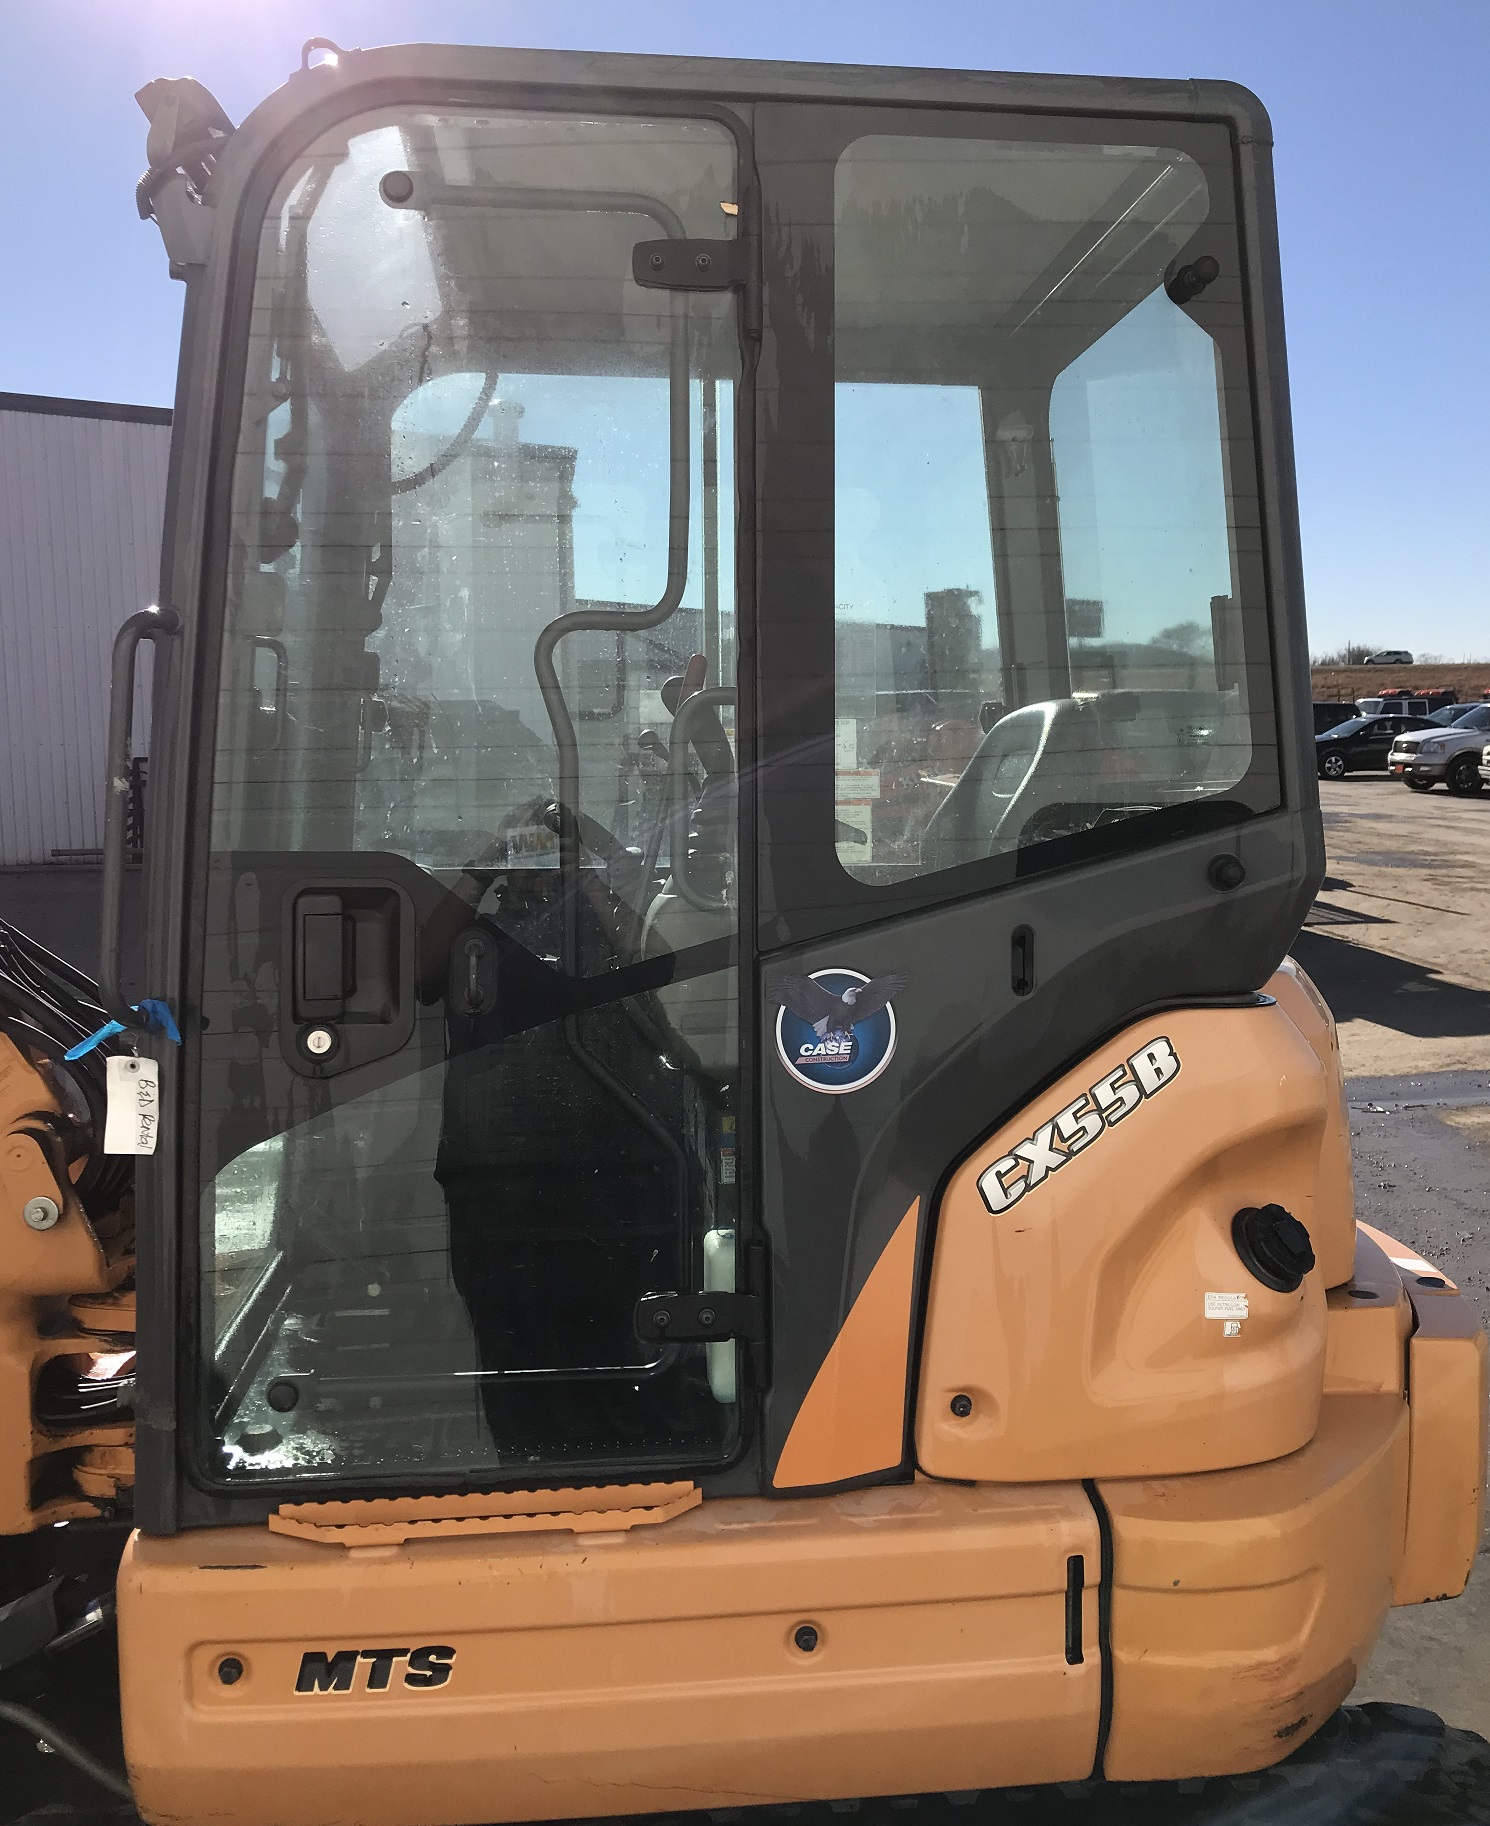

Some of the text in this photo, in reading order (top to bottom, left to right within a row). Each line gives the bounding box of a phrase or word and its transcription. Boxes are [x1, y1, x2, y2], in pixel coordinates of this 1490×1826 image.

[800, 1042, 853, 1056] CASE
[137, 1113, 156, 1150] Rental
[976, 1036, 1181, 1215] CX55B
[294, 1646, 457, 1696] MTS
